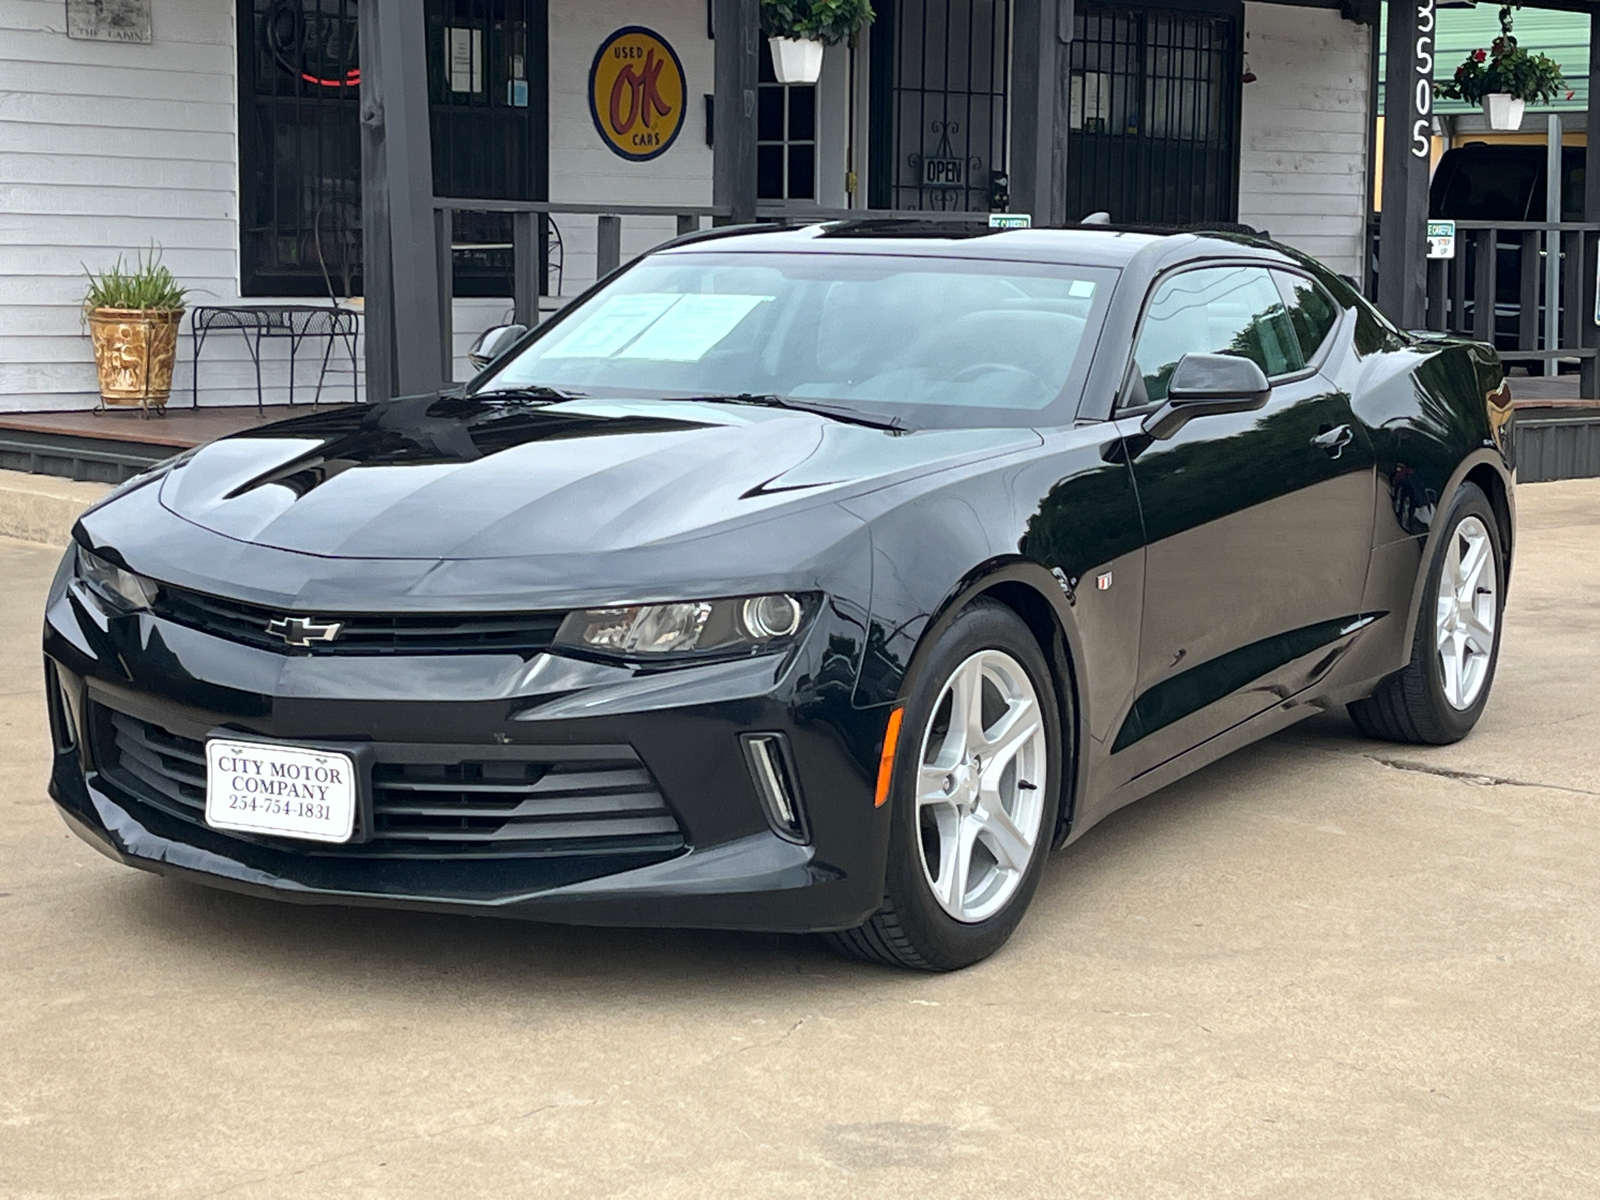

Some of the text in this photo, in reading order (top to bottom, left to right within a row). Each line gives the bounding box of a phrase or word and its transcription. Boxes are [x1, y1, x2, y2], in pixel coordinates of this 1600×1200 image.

[614, 46, 643, 59] USED
[609, 47, 672, 135] OK
[1412, 0, 1434, 158] 3505
[632, 132, 660, 146] CARS
[926, 160, 961, 183] OPEN
[218, 755, 344, 785] CITY MOTOR
[232, 775, 330, 802] COMPANY
[229, 793, 331, 821] 254-754-1831
